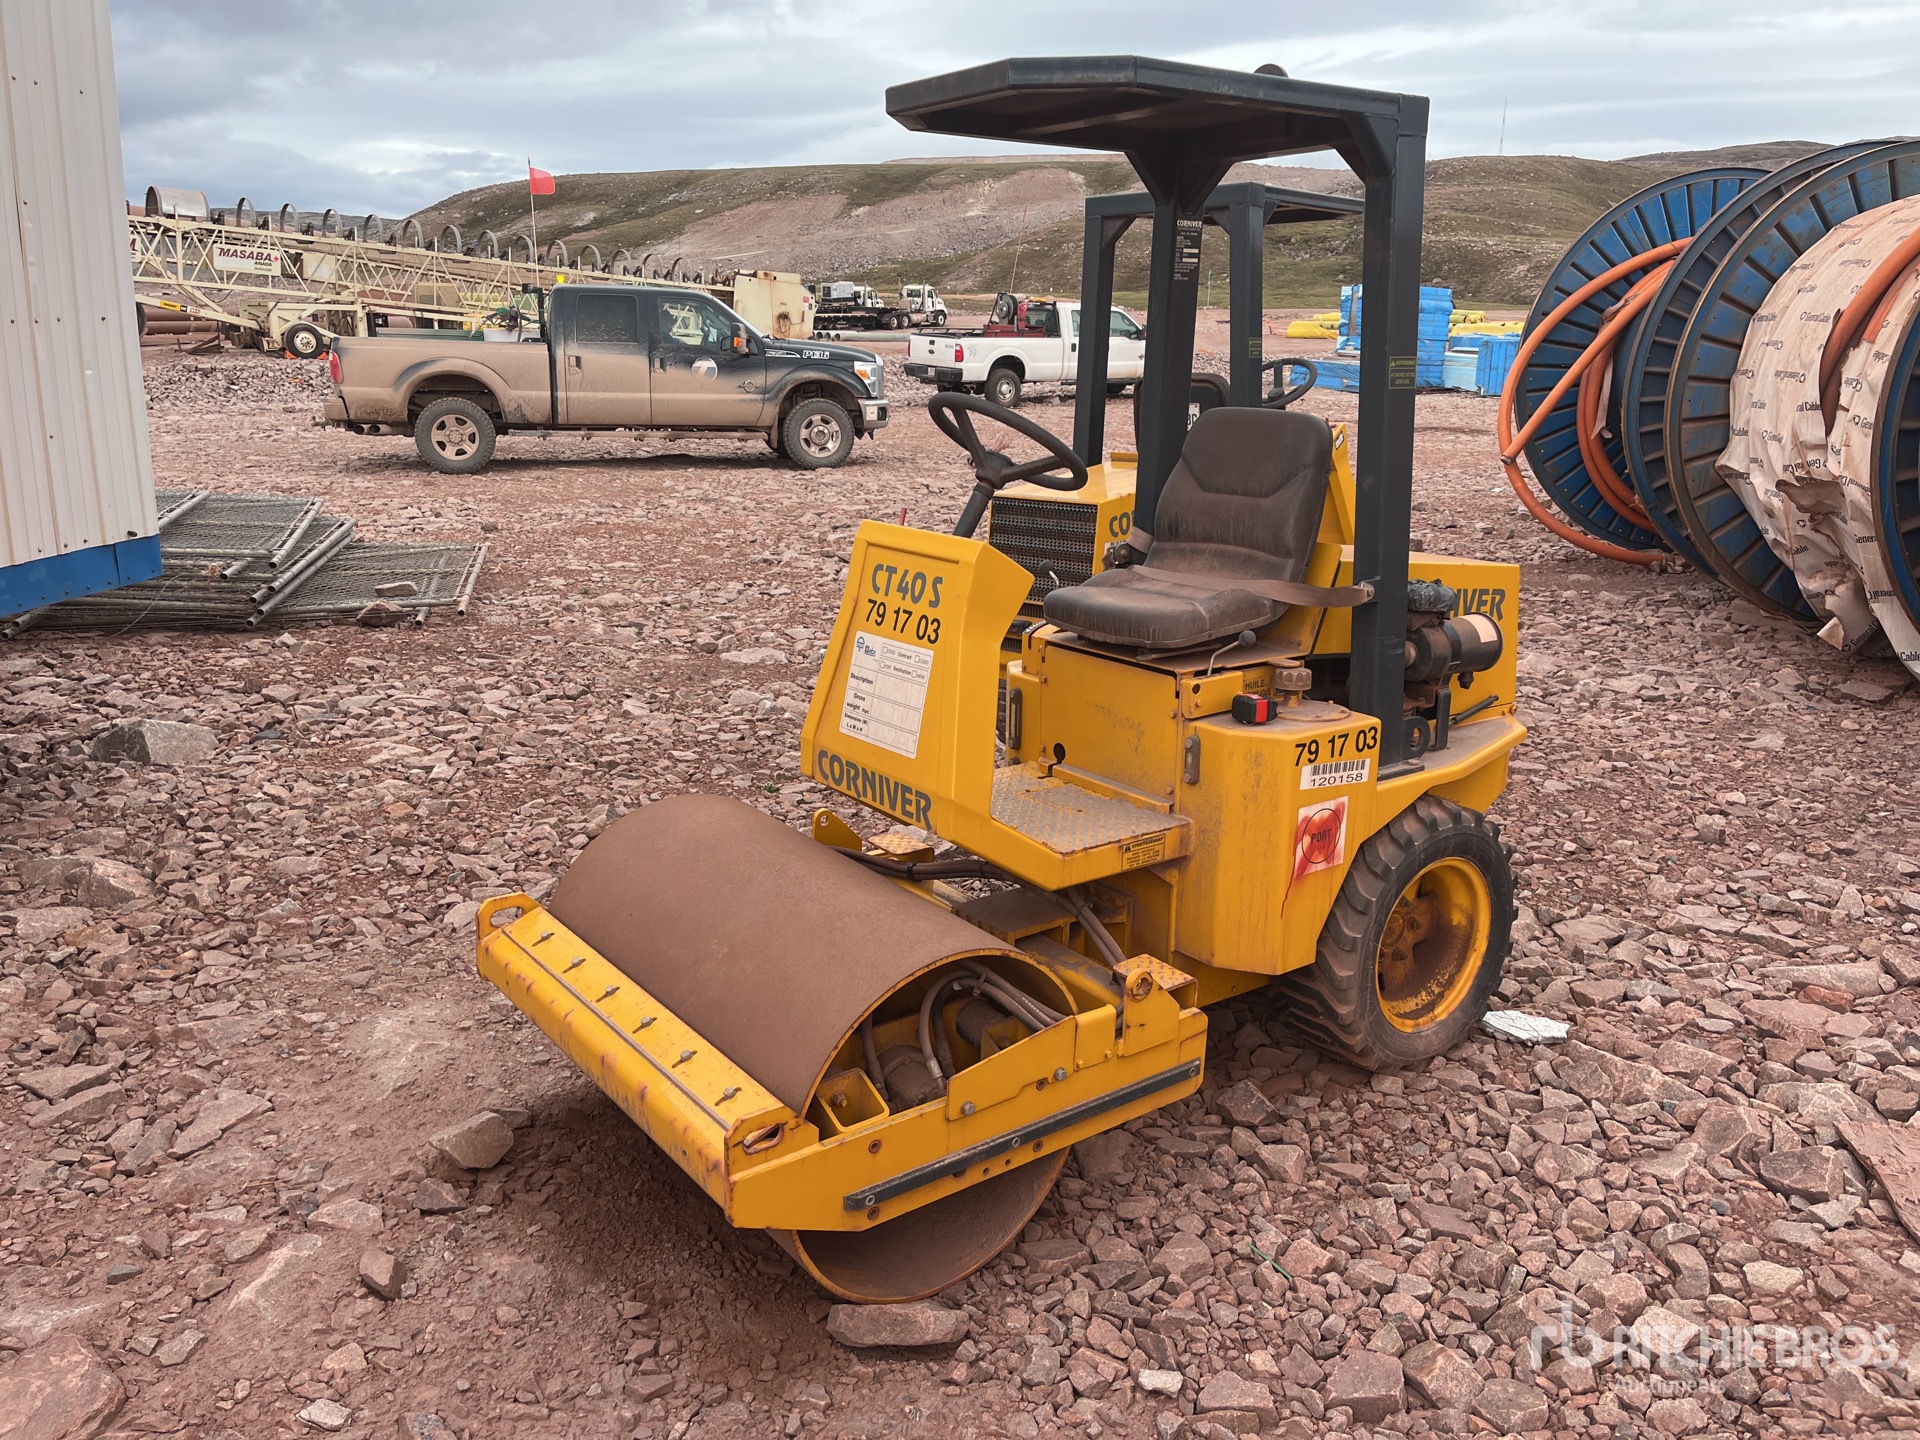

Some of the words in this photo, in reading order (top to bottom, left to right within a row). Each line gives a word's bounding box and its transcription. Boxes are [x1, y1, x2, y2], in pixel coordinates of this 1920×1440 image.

[1176, 220, 1202, 228] CORNIVER
[217, 247, 273, 262] MASABA
[866, 598, 887, 627] 79
[893, 606, 913, 635] 17
[915, 614, 941, 644] 03
[1850, 624, 1875, 646] General
[850, 672, 873, 685] Description
[1245, 679, 1265, 690] HUILE
[853, 692, 866, 702] Gross
[846, 702, 860, 711] weight
[844, 712, 861, 723] Dimension
[1295, 739, 1319, 766] 79
[1327, 733, 1349, 758] 17
[1356, 726, 1378, 753] 03
[1310, 772, 1363, 787] 120158
[818, 750, 932, 830] CORNIVER
[1311, 828, 1332, 844] PORT
